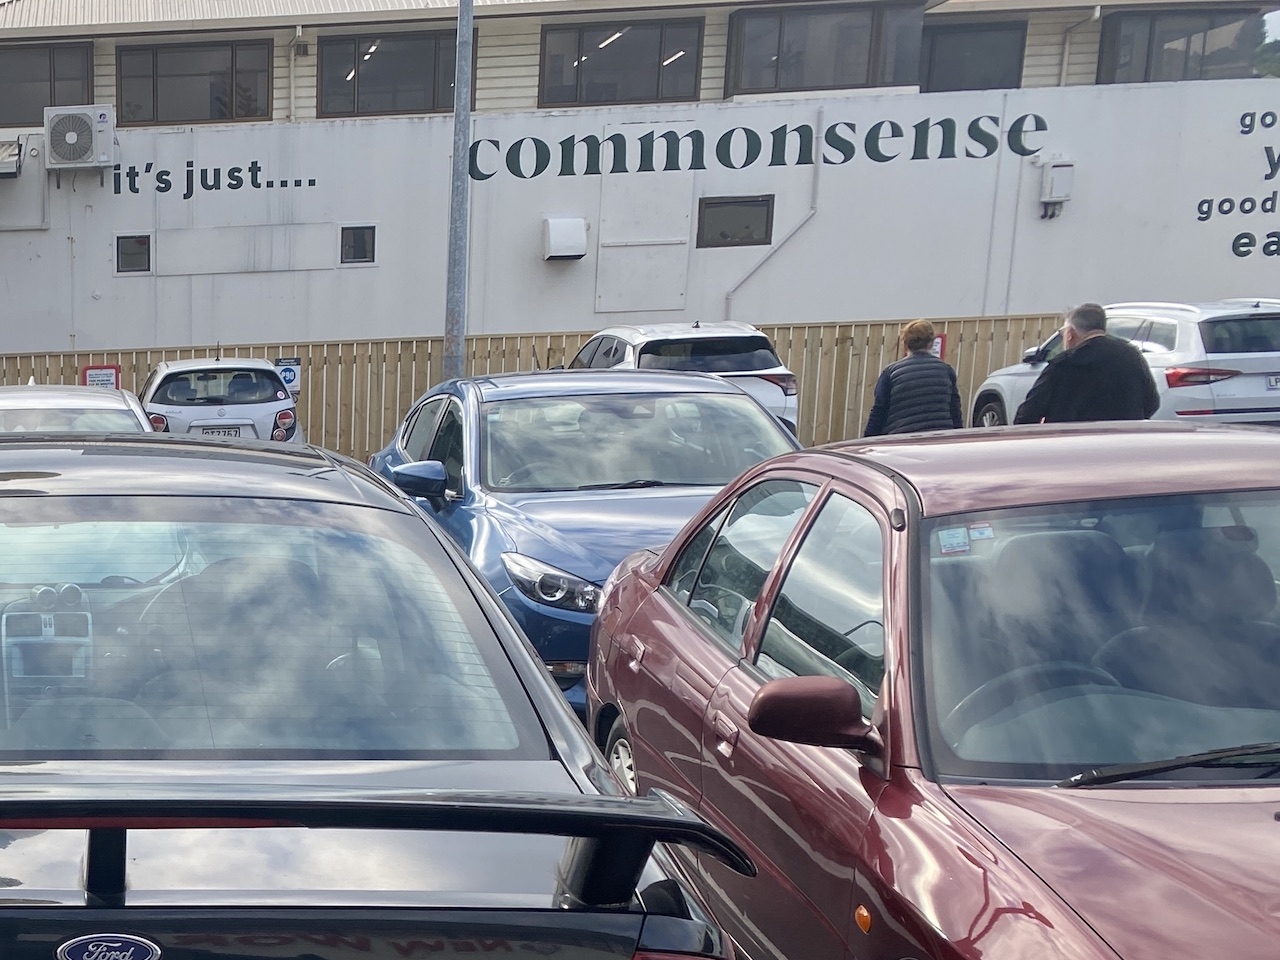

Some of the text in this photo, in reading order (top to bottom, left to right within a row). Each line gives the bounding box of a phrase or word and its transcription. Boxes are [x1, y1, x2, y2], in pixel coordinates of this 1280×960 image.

[468, 113, 1048, 181] commonsense
[113, 162, 172, 195] it's
[1197, 190, 1278, 222] good
